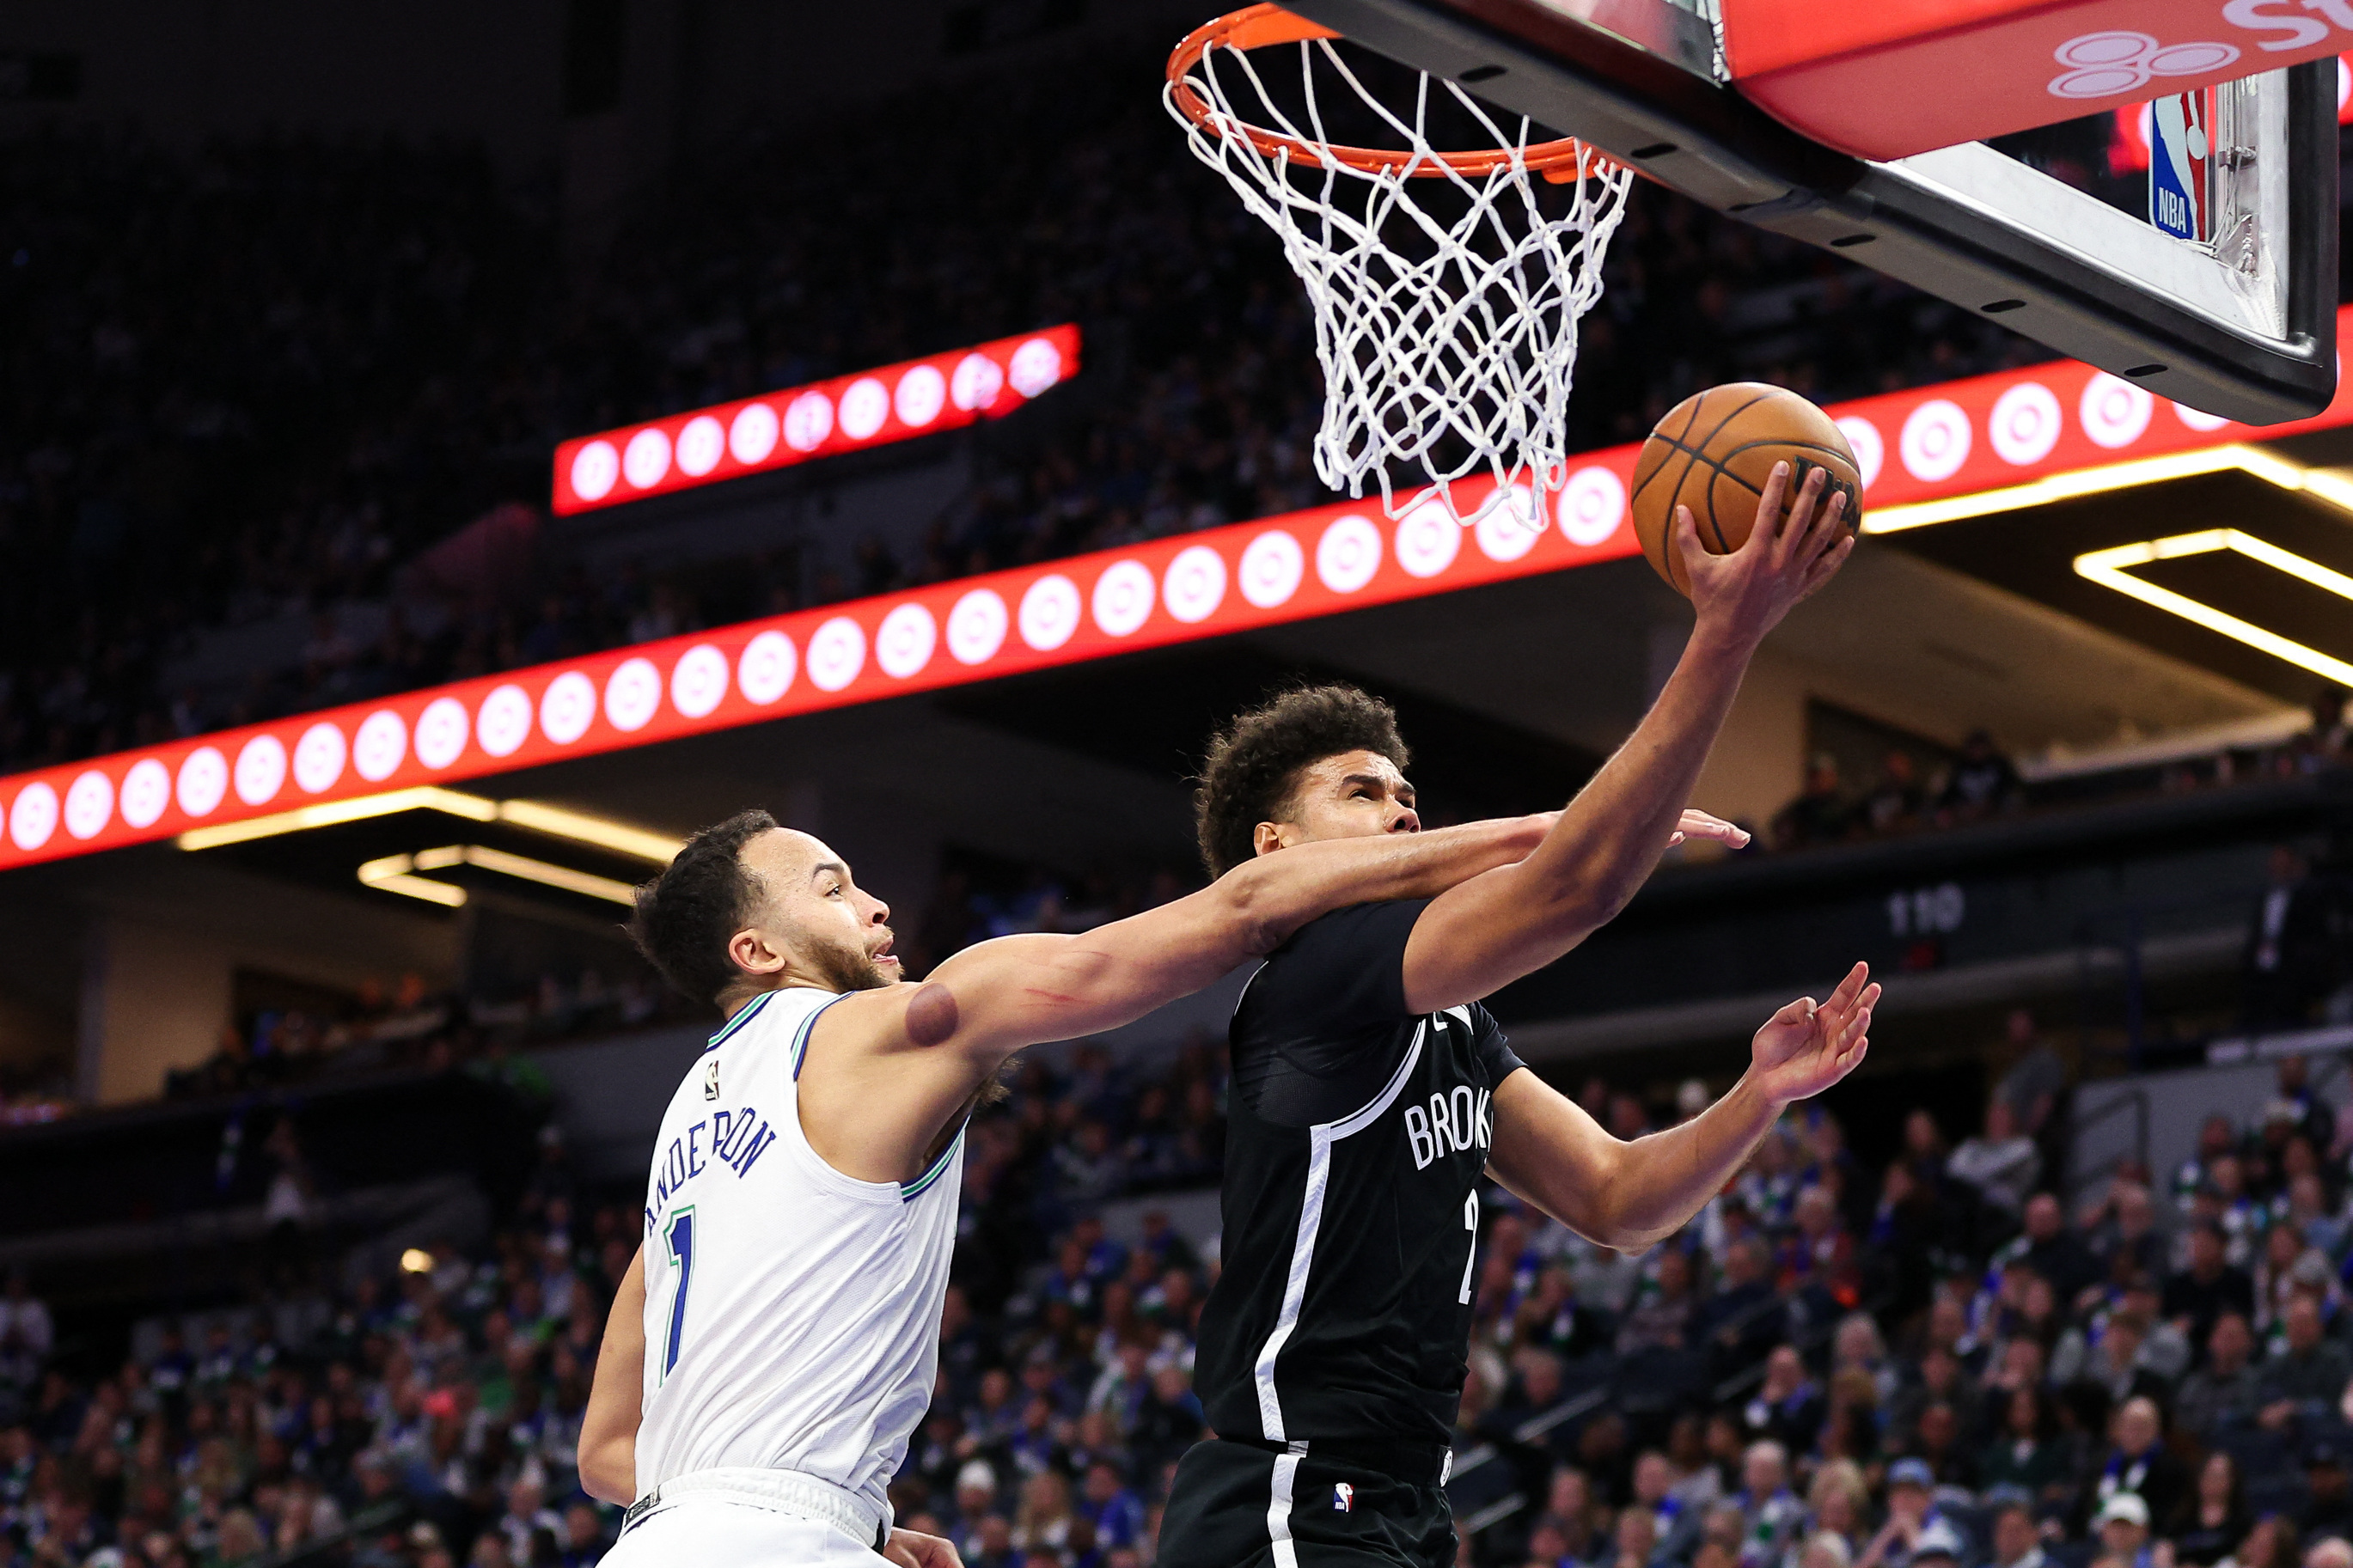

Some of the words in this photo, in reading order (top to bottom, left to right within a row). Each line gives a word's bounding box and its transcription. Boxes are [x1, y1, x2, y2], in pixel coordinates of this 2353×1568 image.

[2158, 186, 2188, 234] NBA
[1890, 882, 1965, 936] 110
[663, 1205, 696, 1388] 1
